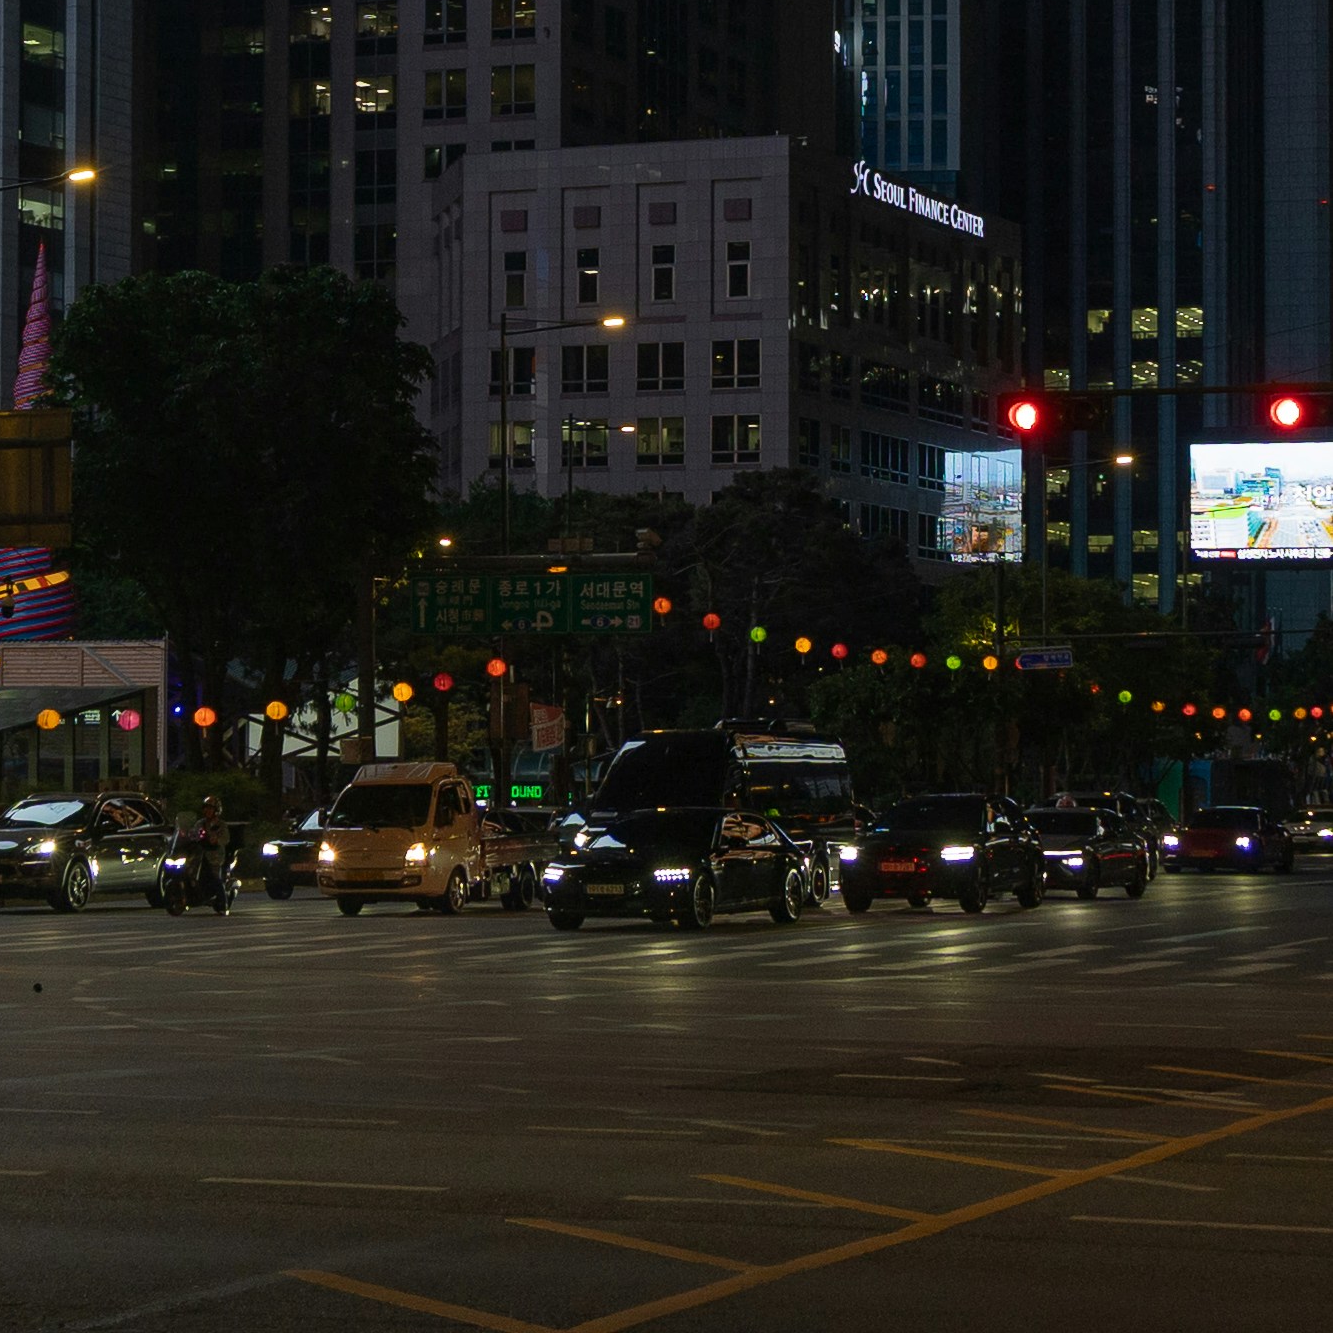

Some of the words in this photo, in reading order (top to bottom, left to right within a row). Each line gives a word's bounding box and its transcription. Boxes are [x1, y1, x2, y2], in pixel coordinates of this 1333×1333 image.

[873, 172, 907, 209] SEOUL
[909, 186, 950, 225] FINANCE
[950, 203, 984, 238] CENTER
[579, 580, 645, 598] 서대문역
[510, 785, 543, 799] OUND
